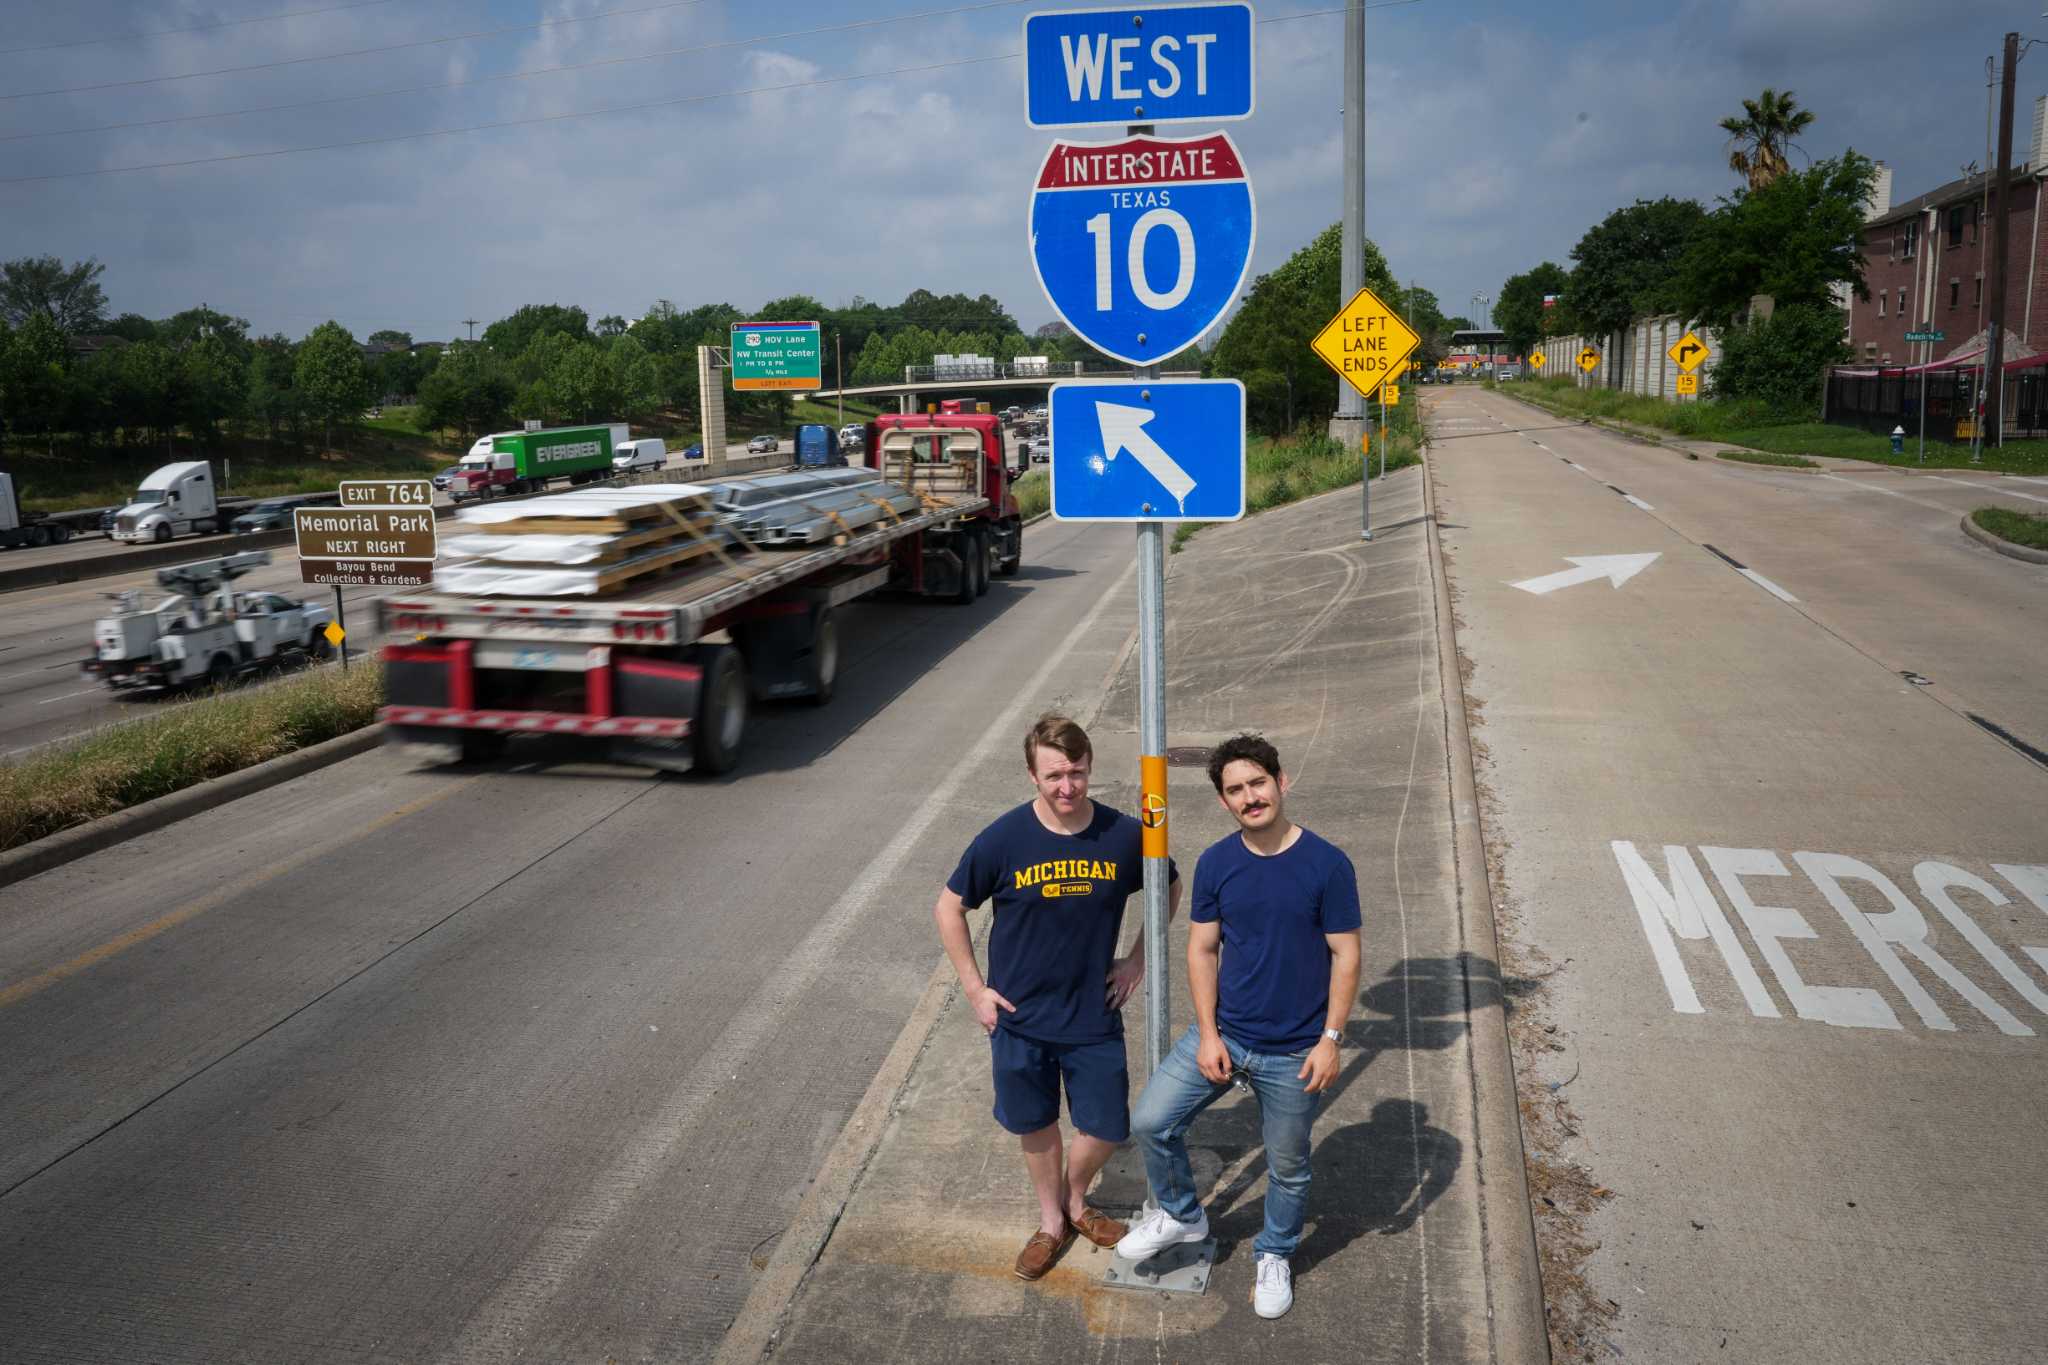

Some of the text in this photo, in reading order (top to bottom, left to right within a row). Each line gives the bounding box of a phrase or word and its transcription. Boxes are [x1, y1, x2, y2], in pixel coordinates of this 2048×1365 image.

[1060, 33, 1217, 102] WEST
[1064, 149, 1215, 183] INTERSTATE
[1111, 190, 1171, 209] TEXAS
[1086, 208, 1196, 312] 10
[1343, 316, 1388, 332] LEFT
[764, 336, 782, 344] HOV
[785, 336, 806, 344] Lane
[1343, 336, 1388, 353] LANE
[736, 348, 816, 359] NW Transit Center
[1343, 356, 1388, 372] ENDS
[1681, 377, 1693, 386] 15
[535, 440, 602, 463] EVERGREEN
[347, 485, 424, 503] EXIT 764
[300, 514, 429, 532] Memorial Park
[326, 540, 406, 554] NEXT RIGHT
[336, 562, 396, 574] Bayou Bend
[314, 573, 422, 585] Collection & Gardens
[1014, 859, 1117, 889] MICHIGAN
[1061, 885, 1090, 893] TENNIS
[1611, 839, 2048, 1037] MERG
